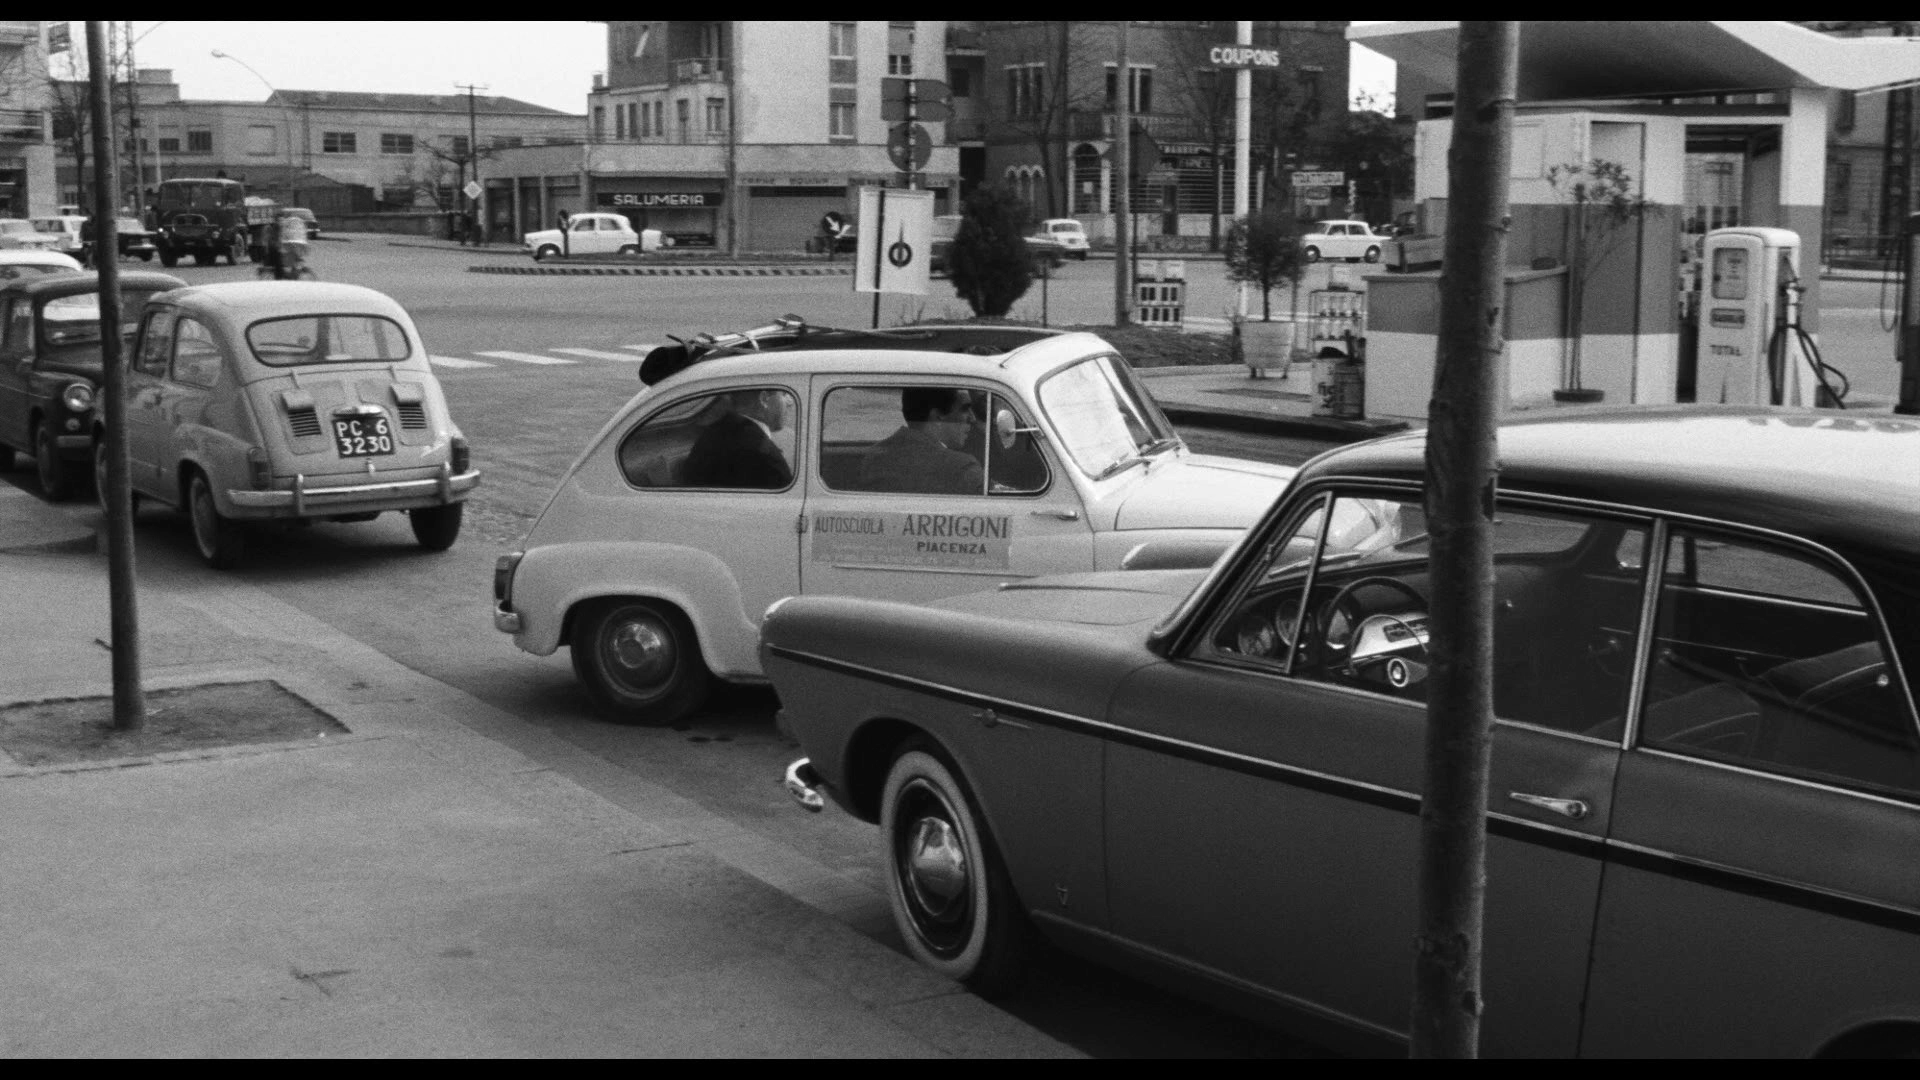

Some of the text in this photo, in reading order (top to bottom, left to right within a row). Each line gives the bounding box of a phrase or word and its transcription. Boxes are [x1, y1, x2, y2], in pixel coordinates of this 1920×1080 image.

[1210, 47, 1279, 67] COUPONS
[613, 194, 705, 206] SALUMERIA
[1709, 344, 1742, 357] TOTAL
[336, 418, 389, 438] PC 6
[340, 435, 392, 456] 3230
[814, 514, 1010, 539] AUTOSCUOLA ARRIGONI
[917, 541, 988, 555] PIACENZA
